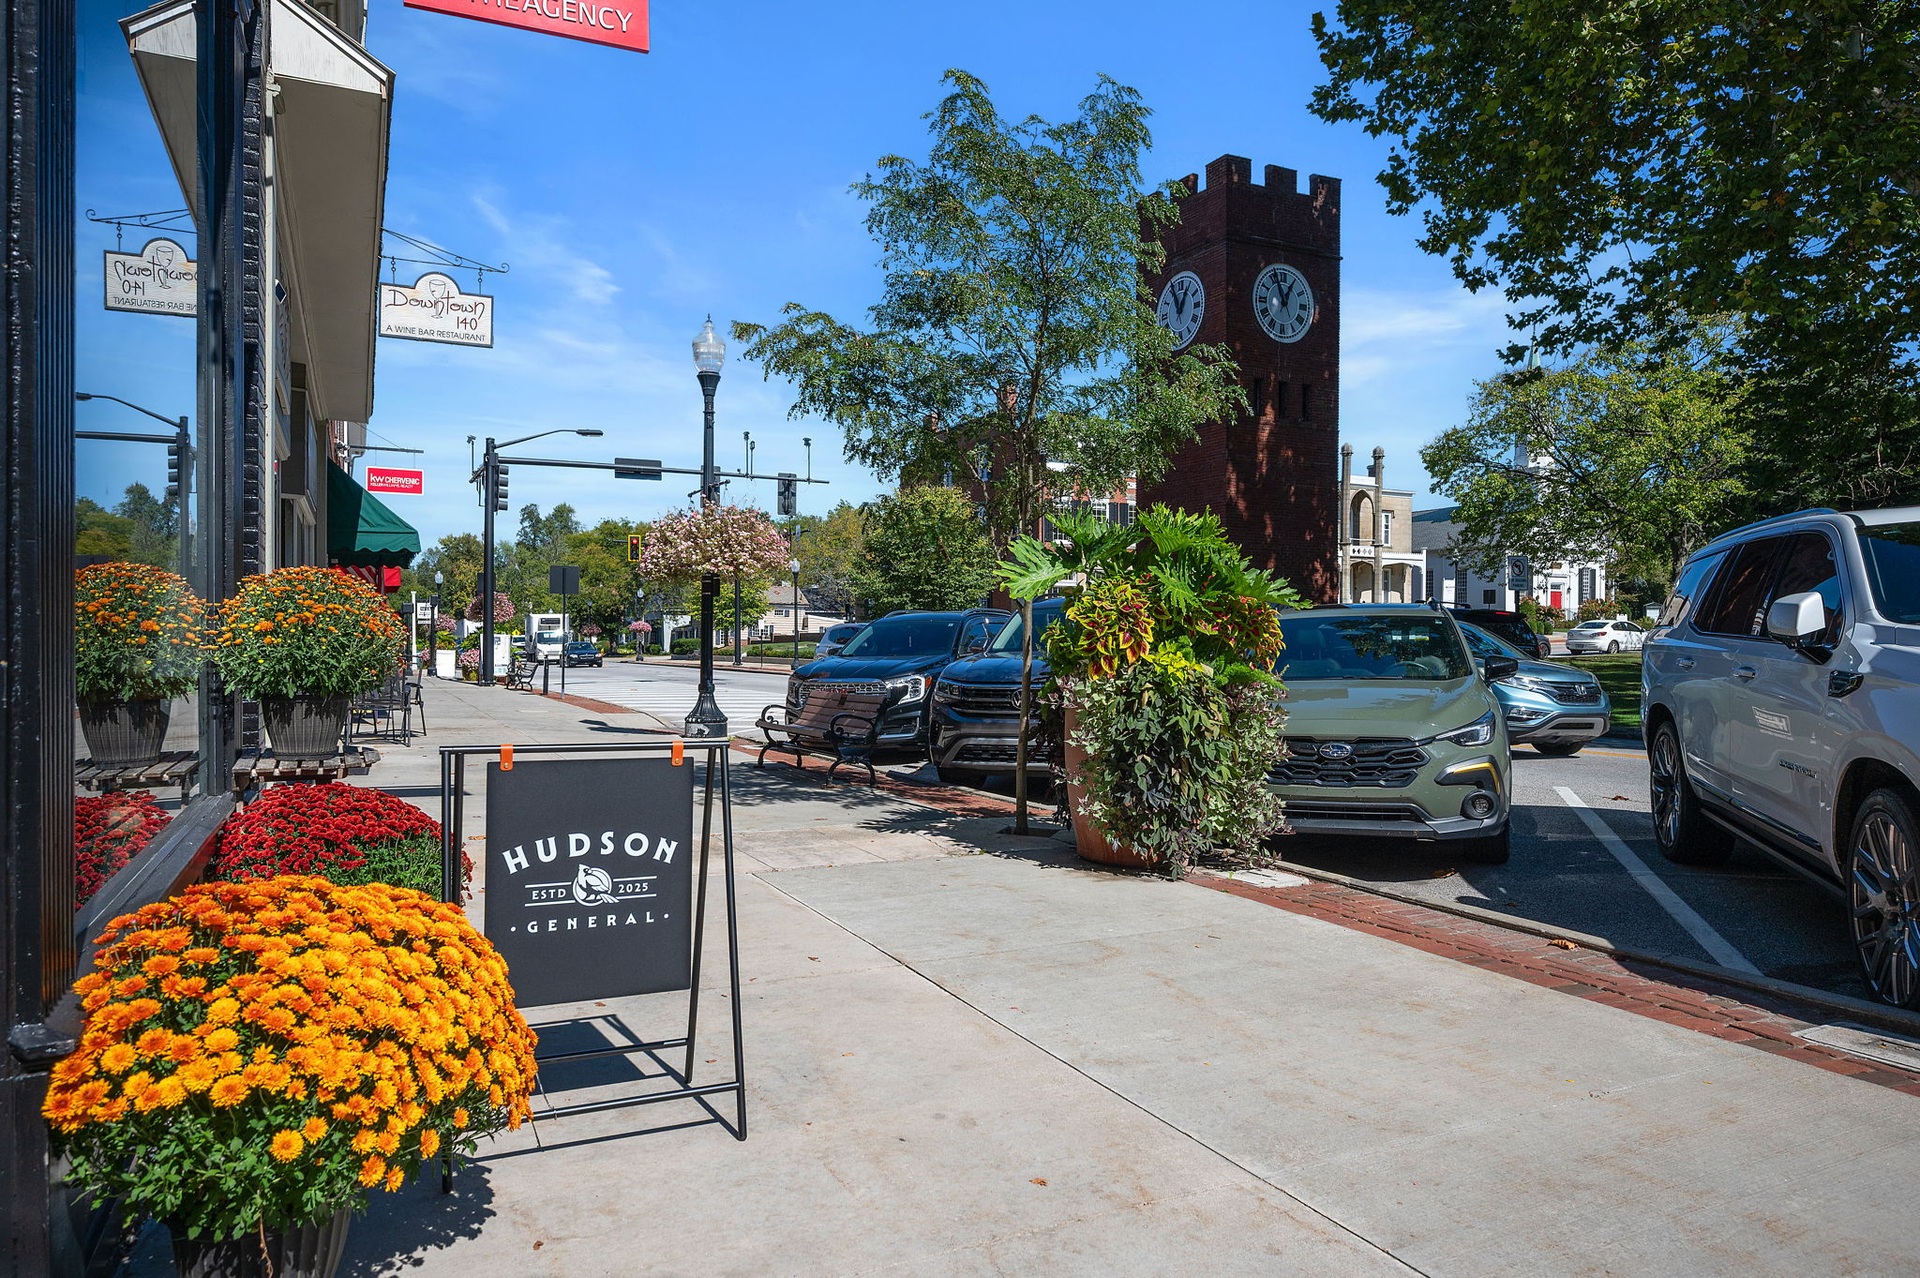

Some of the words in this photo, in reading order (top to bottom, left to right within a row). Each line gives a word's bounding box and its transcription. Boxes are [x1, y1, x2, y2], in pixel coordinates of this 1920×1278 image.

[471, 0, 633, 32] AGENCY
[385, 289, 485, 320] Downtown
[385, 324, 393, 332] A
[394, 326, 416, 335] WINE
[418, 328, 435, 337] BAR
[436, 330, 486, 342] RESTAURANT
[456, 316, 478, 331] 140
[385, 476, 420, 485] CHERVENIC
[502, 831, 679, 875] HUDSON
[531, 888, 567, 900] ESTD
[618, 882, 649, 894] 2025
[527, 911, 655, 934] GENERAL
